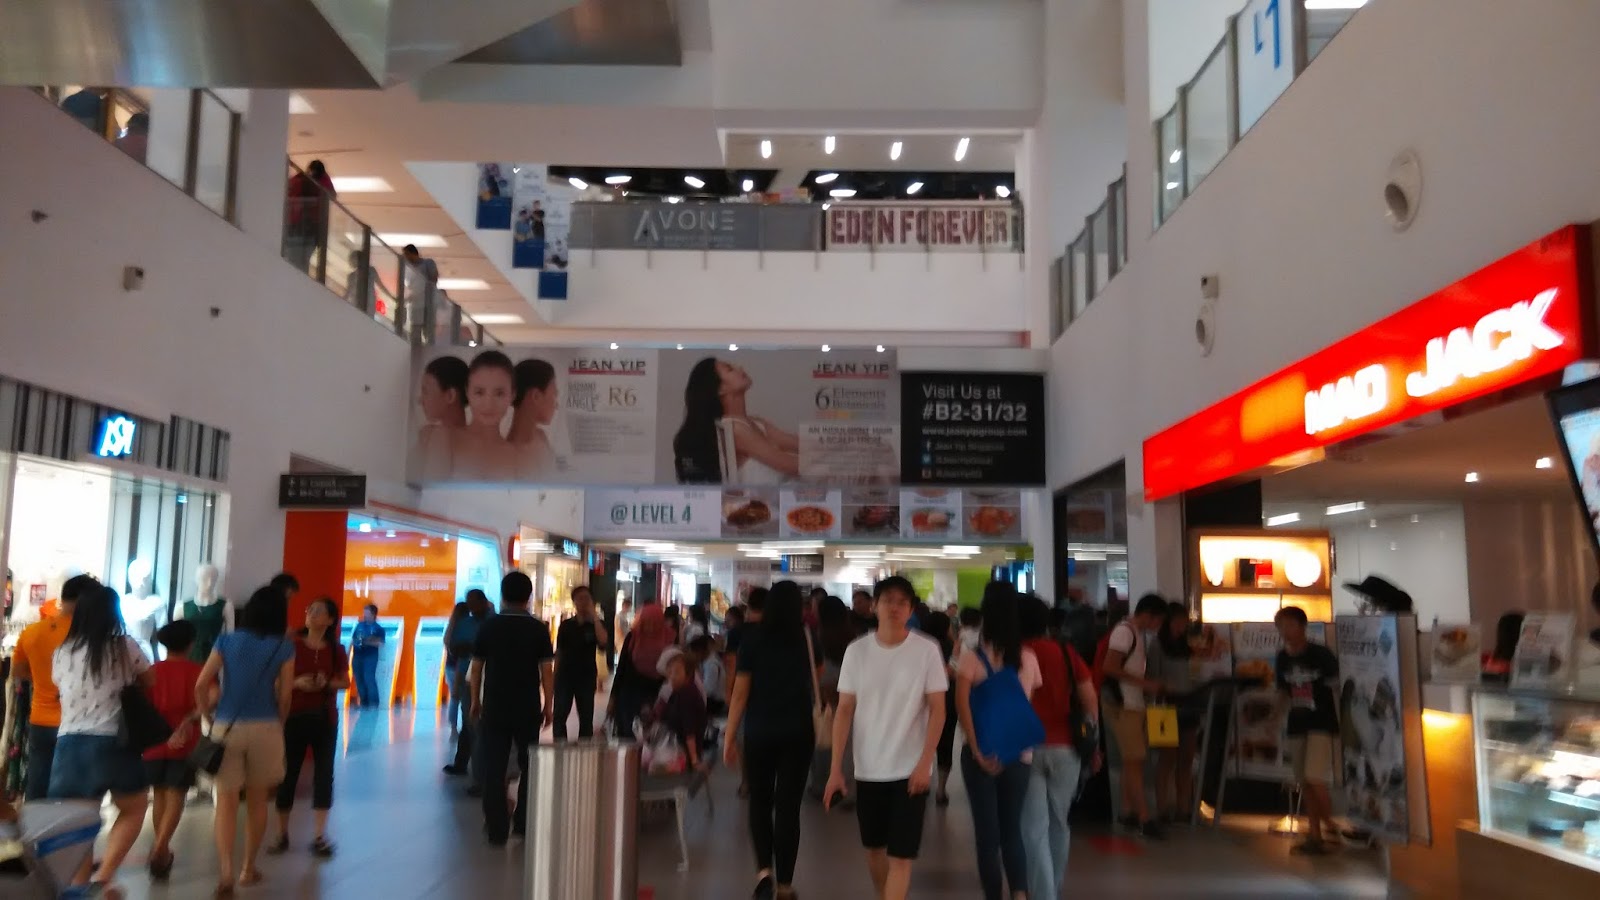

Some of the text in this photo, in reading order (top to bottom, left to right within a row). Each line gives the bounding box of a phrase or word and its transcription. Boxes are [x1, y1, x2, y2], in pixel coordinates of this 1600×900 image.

[633, 208, 735, 242] AVONE
[831, 210, 1008, 245] EDEN FOREVER
[568, 359, 646, 372] JEAN YIP
[813, 362, 889, 375] JEAN YIP
[1305, 287, 1564, 435] MAD JACK
[609, 385, 637, 407] R6
[815, 386, 830, 410] 6
[922, 383, 1001, 400] Visit Us at
[923, 401, 1027, 422] #B2-31/32
[610, 503, 692, 525] @ LEVEL 4
[364, 554, 425, 569] Registration
